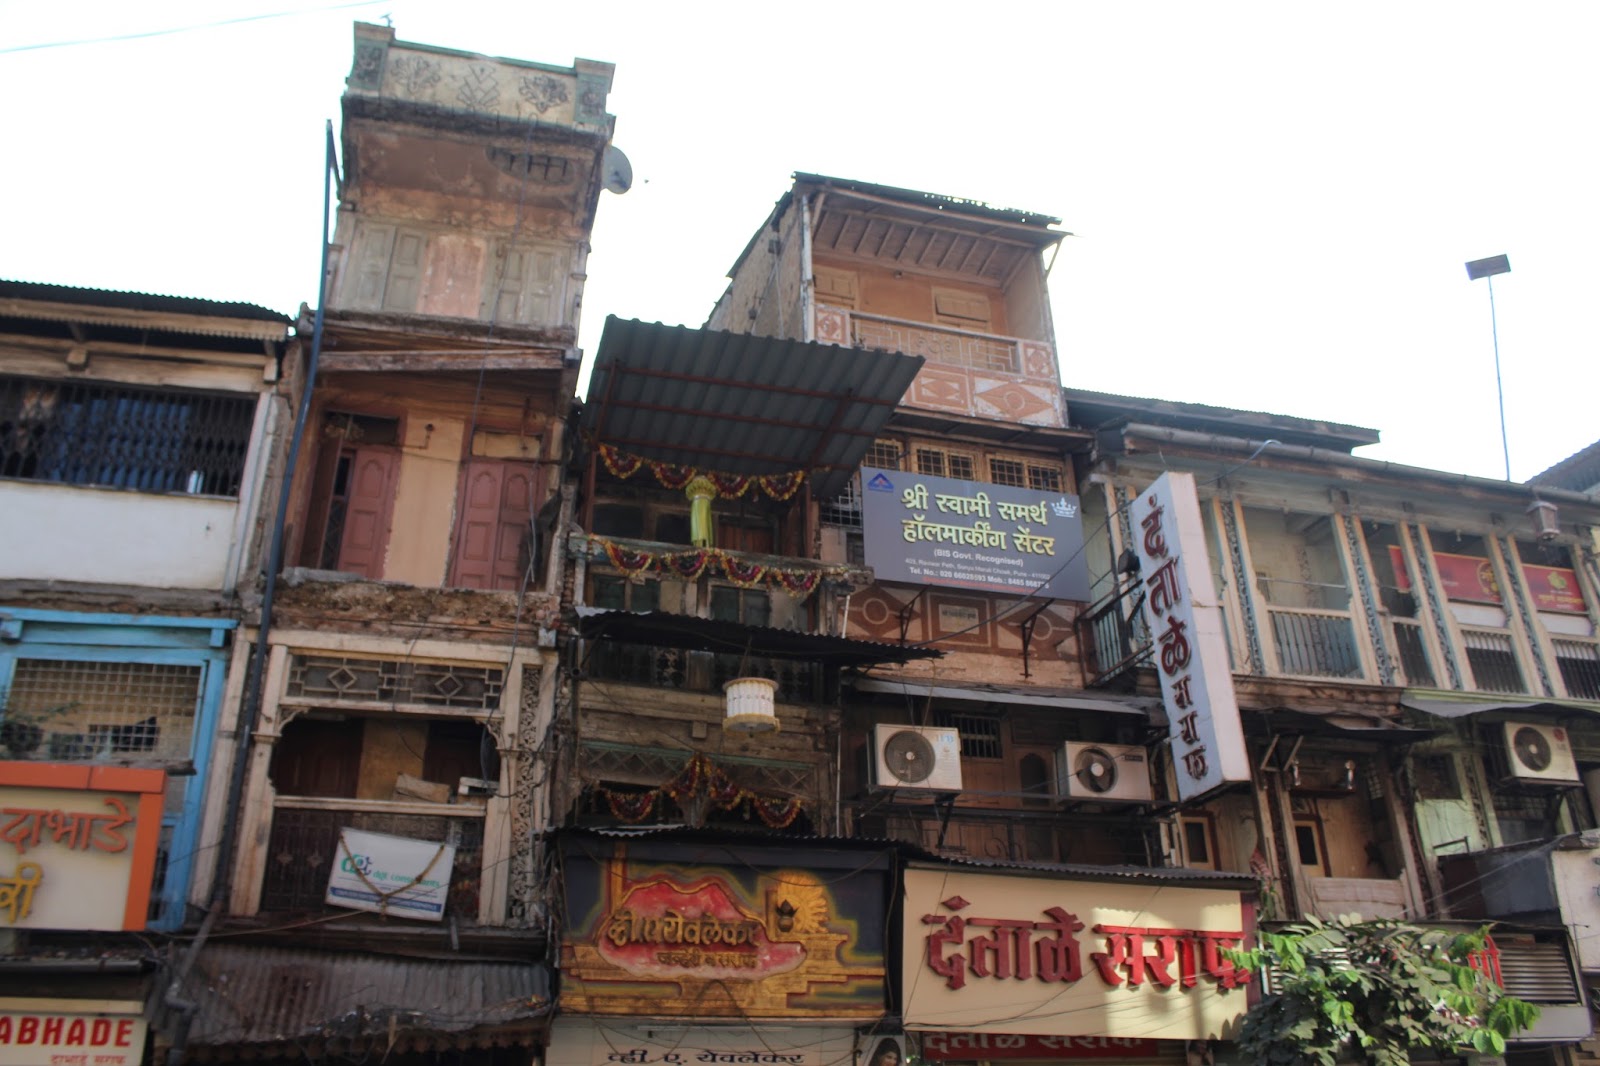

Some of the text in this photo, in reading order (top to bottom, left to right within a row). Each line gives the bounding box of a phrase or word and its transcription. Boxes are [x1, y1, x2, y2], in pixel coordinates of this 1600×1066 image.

[901, 483, 1048, 525] श्री स्वामी समर्थ
[933, 549, 1024, 567] (BIS Govt. Recognised)
[1012, 525, 1055, 555] सेंटर
[1140, 493, 1192, 677] दंताळे
[0, 798, 133, 854] दाभाडे
[921, 895, 1085, 991] दंताळे
[697, 1050, 805, 1064] येवलेकर
